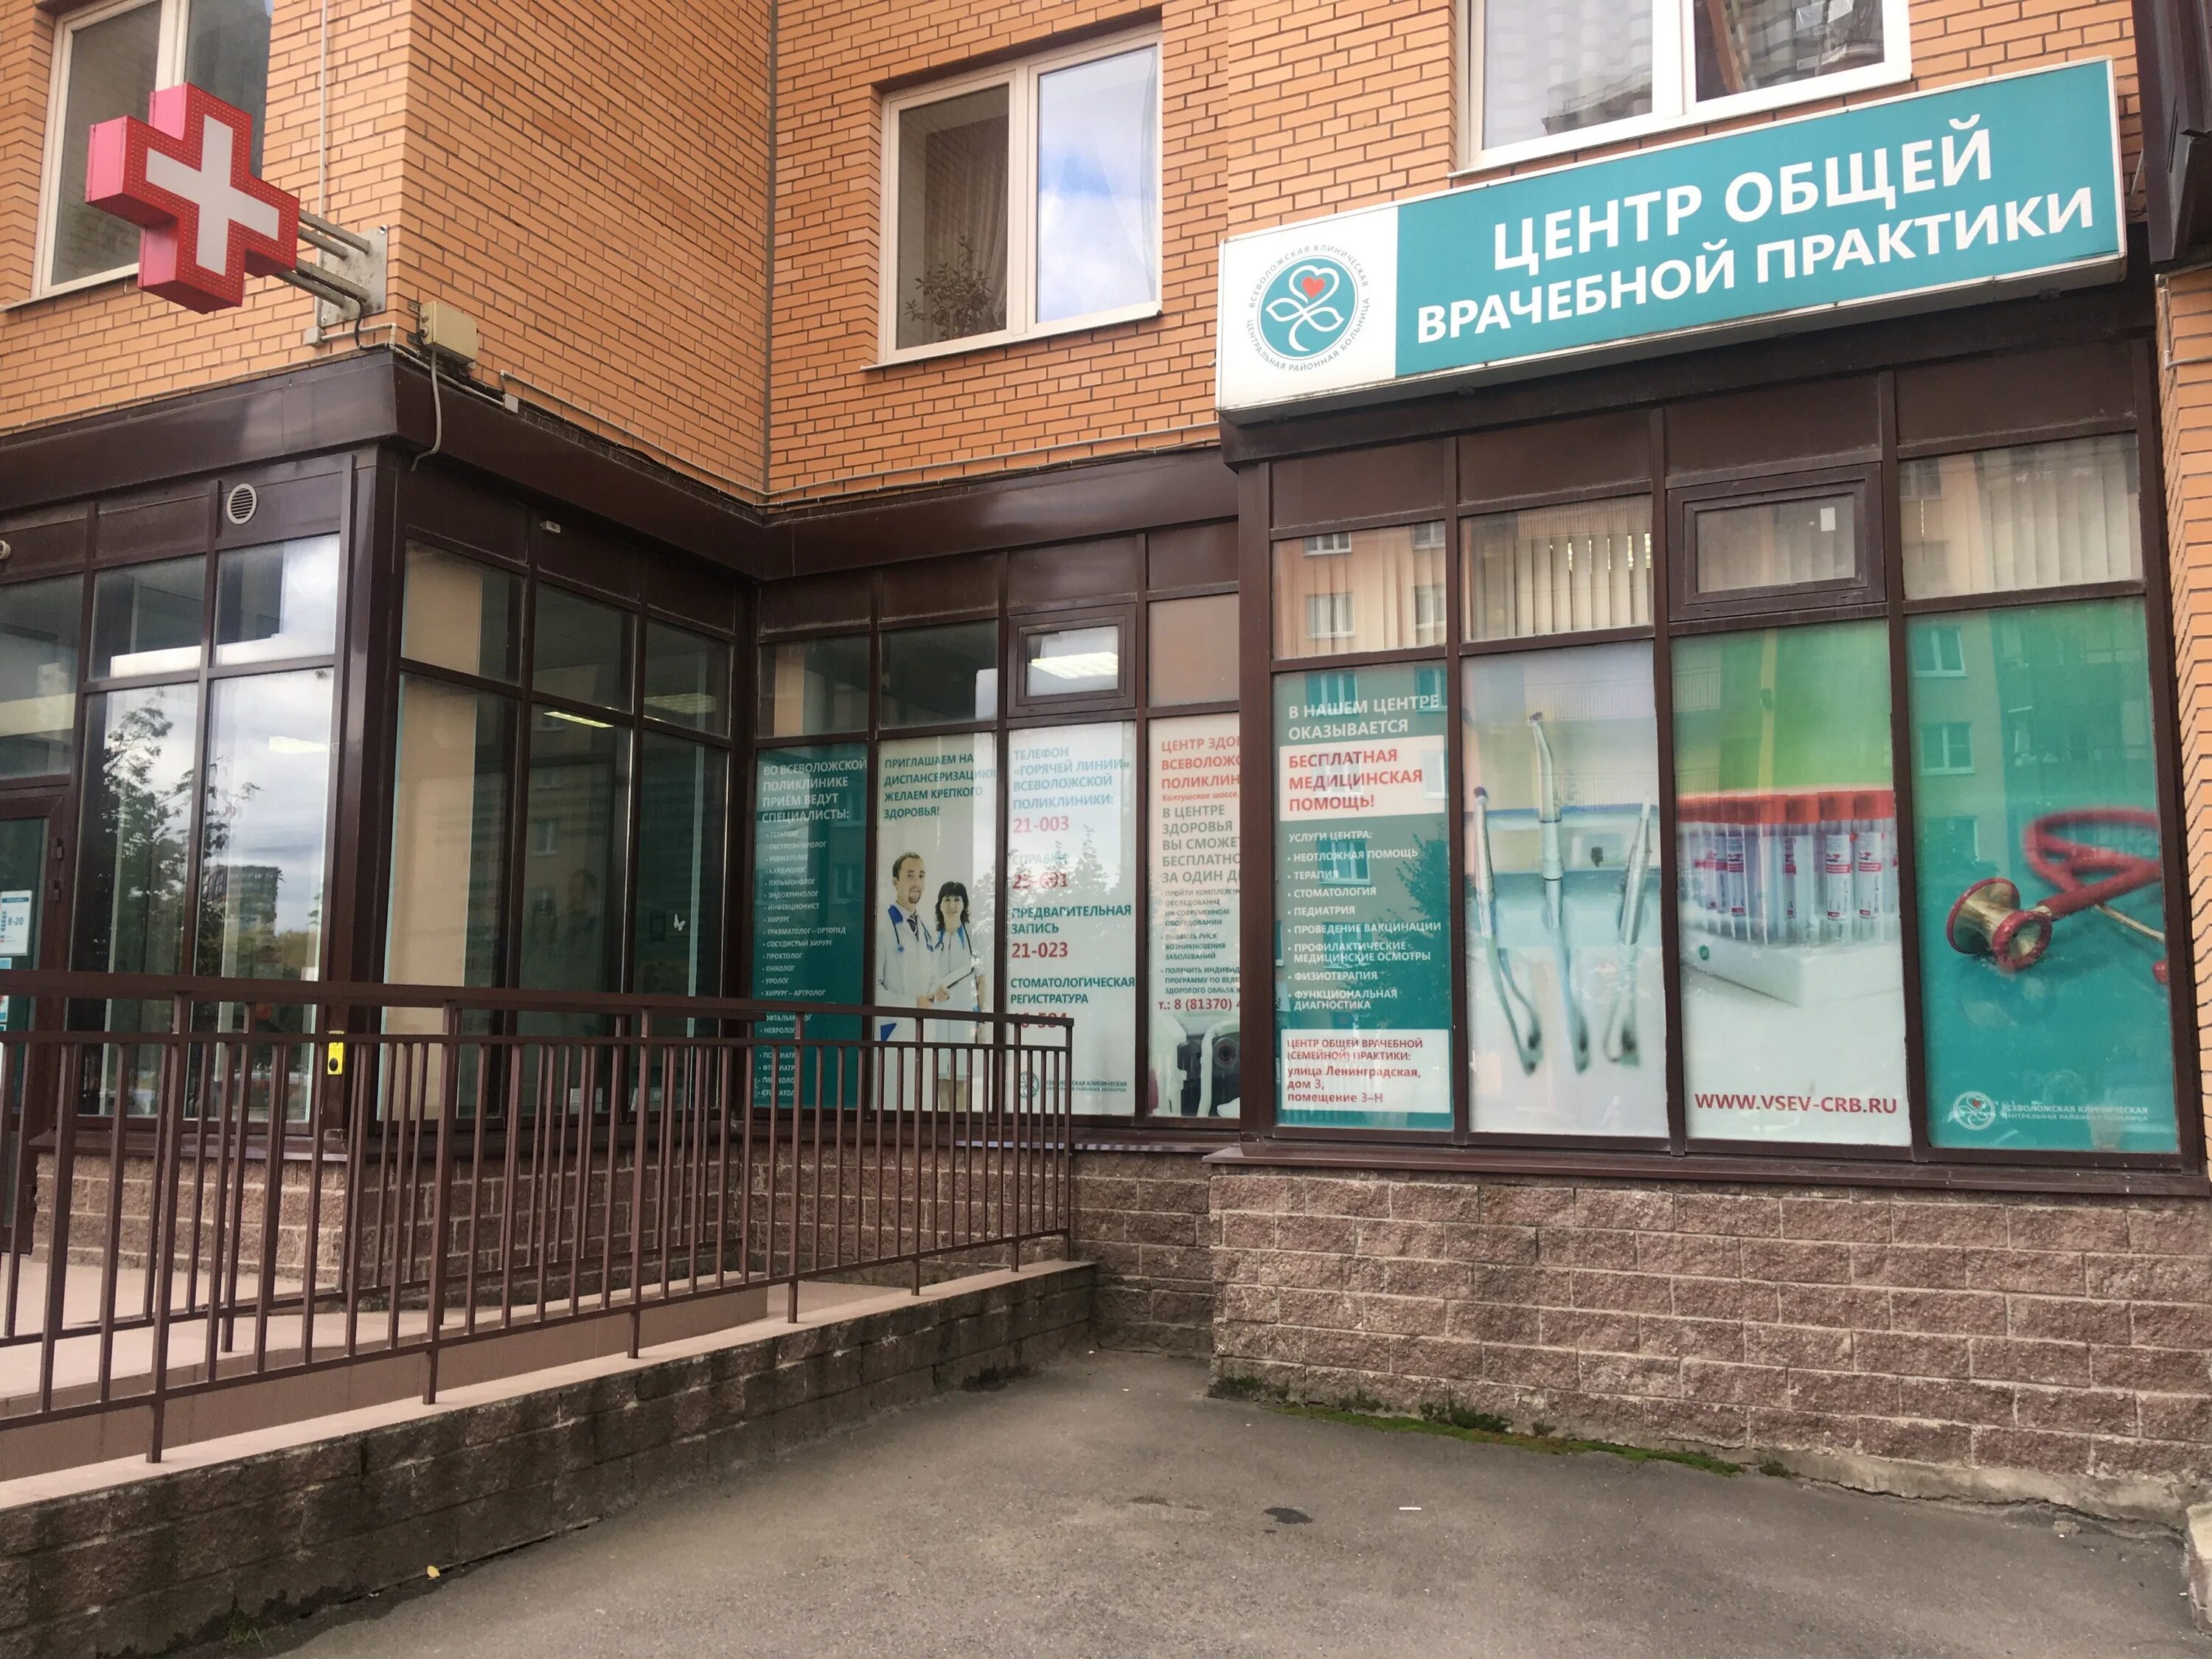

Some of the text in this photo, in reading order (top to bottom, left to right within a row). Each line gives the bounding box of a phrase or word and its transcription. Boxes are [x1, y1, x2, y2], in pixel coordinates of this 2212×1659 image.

[1494, 114, 1992, 275] ЦЕНТР ОБЩЕЙ
[1417, 187, 2093, 344] ВРАЧЕБНОЙ ПРАКТИКИ
[1249, 244, 1368, 308] ВСЕВОЛОЖСКАЯ КЛИНИЧЕСКАЯ
[1246, 298, 1370, 372] ЦЕНТРАЛЬНАЯ РАЙОННАЯ БОЛЬНИЦА
[1289, 695, 1439, 719] В НАШЕМ ЦЕНТРЕ
[1289, 719, 1408, 740] ОКАЗЫВАЕТСЯ
[1014, 747, 1068, 760] ТЕЛЕФОН
[1162, 739, 1204, 754] ЦЕНТР
[885, 754, 973, 768] ПРИГЛАШАЕМ НА
[1289, 748, 1398, 768] БЕСПЛАТНАЯ
[763, 757, 868, 776] ВО ВСЕВОЛОЖСКОЙ
[1014, 759, 1130, 776] «ГОРЯЧЕЙ ЛИНИИ»
[763, 776, 848, 792] ПОЛИКЛИНИКЕ
[1013, 773, 1112, 792] ВСЕВОЛОЖСКОЙ
[1289, 769, 1422, 791] МЕДИЦИНСКАЯ
[762, 793, 838, 807] ПРИЁМ ВЕДУТ
[885, 786, 983, 801] ЖЕЛАЕМ КРЕПКОГО
[1013, 793, 1113, 810] ПОЛИКЛИНИКИ:
[1289, 794, 1374, 811] ПОМОЩЬ!
[762, 809, 849, 824] СПЕЦИАЛИСТЫ:
[884, 806, 939, 820] ЗДОРОВЬЯ!
[1163, 804, 1225, 820] В ЦЕНТРЕ
[1013, 815, 1069, 833] 21-003
[1162, 821, 1233, 837] ЗДОРОВЬЯ
[1289, 830, 1372, 842] УСЛУГИ ЦЕНТРА:
[1163, 839, 1182, 850] ВЫ
[1163, 853, 1240, 867] БЕСПЛАТНО
[1294, 848, 1418, 862] НЕОТЛОЖНАЯ ПОМОЩЬ
[1162, 870, 1240, 884] ЗА ОДИН Д
[1294, 870, 1338, 880] ТЕРАПИЯ
[1294, 886, 1377, 898] СТОМАТОЛОГИЯ
[1165, 899, 1220, 907] ОБСЛЕДОВАНИЕ
[1294, 905, 1355, 917] ПЕДИАТРИЯ
[1011, 923, 1059, 934] ЗАПИСЬ
[1294, 922, 1441, 934] ПРОВЕДЕНИЕ ВАКЦИНАЦИИ
[767, 939, 808, 947] СОСУДИСТЫЙ
[1294, 941, 1406, 952] ПРОФИЛАКТИЧЕСКИЕ
[1012, 942, 1068, 959] 21-023
[1294, 951, 1430, 963] МЕДИЦИНСКИЕ ОСМОТРЫ
[1010, 977, 1135, 988] СТОМАТОЛОГИЧЕСКАЯ
[1294, 970, 1377, 981] ФИЗИОТЕРАПИЯ
[1010, 993, 1089, 1004] РЕГИСТРАТУРА
[1294, 989, 1398, 1001] ФУНКЦИОНАЛЬНАЯ
[1174, 998, 1181, 1009] 8
[1186, 998, 1232, 1012] (81370)
[1294, 1001, 1371, 1011] ДИАГНОСТИКА
[1287, 1037, 1422, 1050] ЦЕНТР ОБЩЕЙ ВРАЧЕБНОЙ
[1287, 1050, 1411, 1061] (СЕМЕЙНОЙ) ПРАКТИКИ:
[1287, 1066, 1421, 1079] улица Ленинградская,
[1287, 1079, 1325, 1091] дом 3,
[1287, 1093, 1357, 1105] помещение
[1695, 1093, 1897, 1114] WWW.VSEV-CRB.RU
